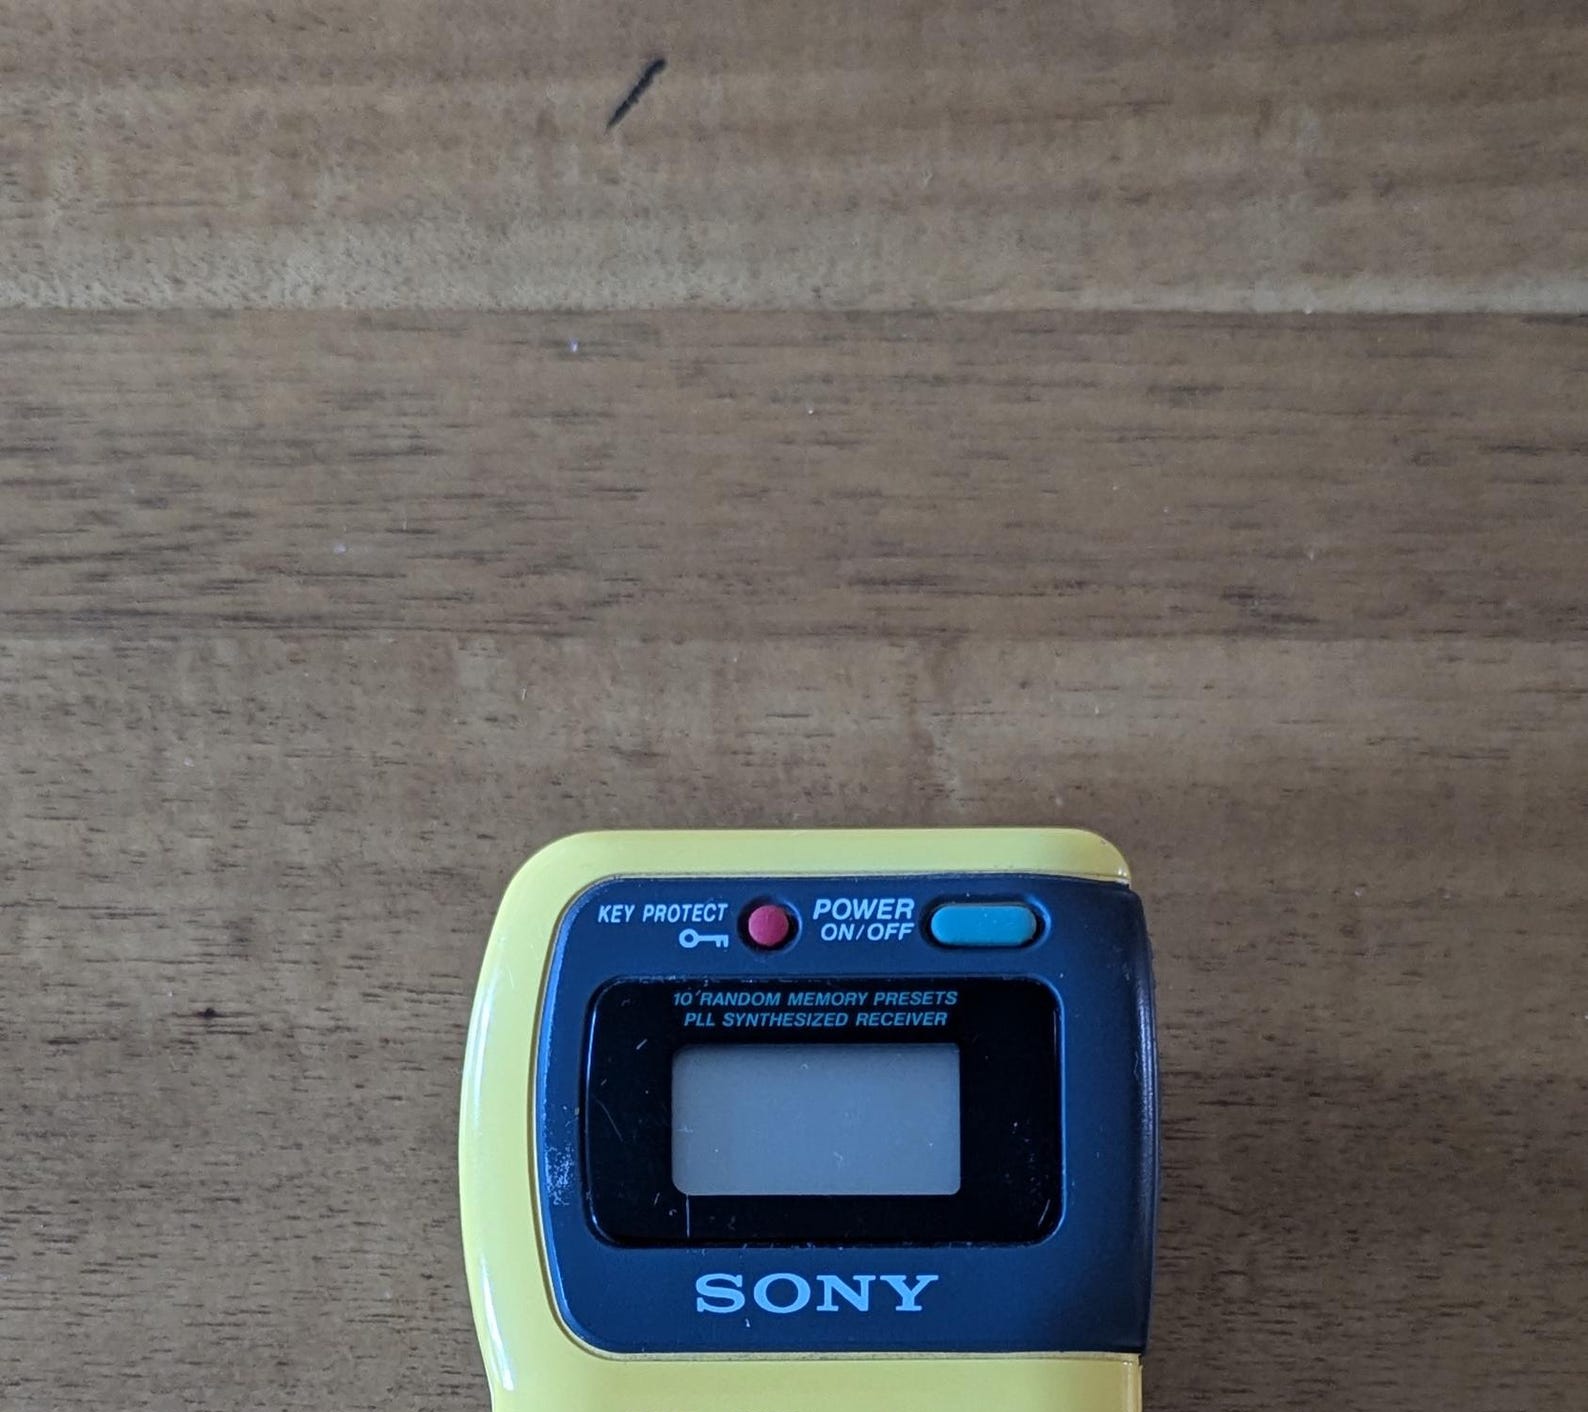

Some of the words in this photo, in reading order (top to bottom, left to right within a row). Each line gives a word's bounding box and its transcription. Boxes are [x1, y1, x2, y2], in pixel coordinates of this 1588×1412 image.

[598, 905, 636, 923] KEY
[643, 903, 728, 923] PROTECT
[813, 898, 914, 920] POWER
[821, 922, 914, 941] ON/OFF
[674, 991, 694, 1006] 10
[700, 991, 781, 1006] RANDOM
[788, 991, 868, 1006] MEMORY
[874, 991, 957, 1006] PRESETS
[684, 1012, 715, 1027] PLL
[722, 1012, 848, 1027] SYNTHESIZED
[856, 1012, 947, 1027] RECEIVER
[696, 1273, 938, 1313] SONY
